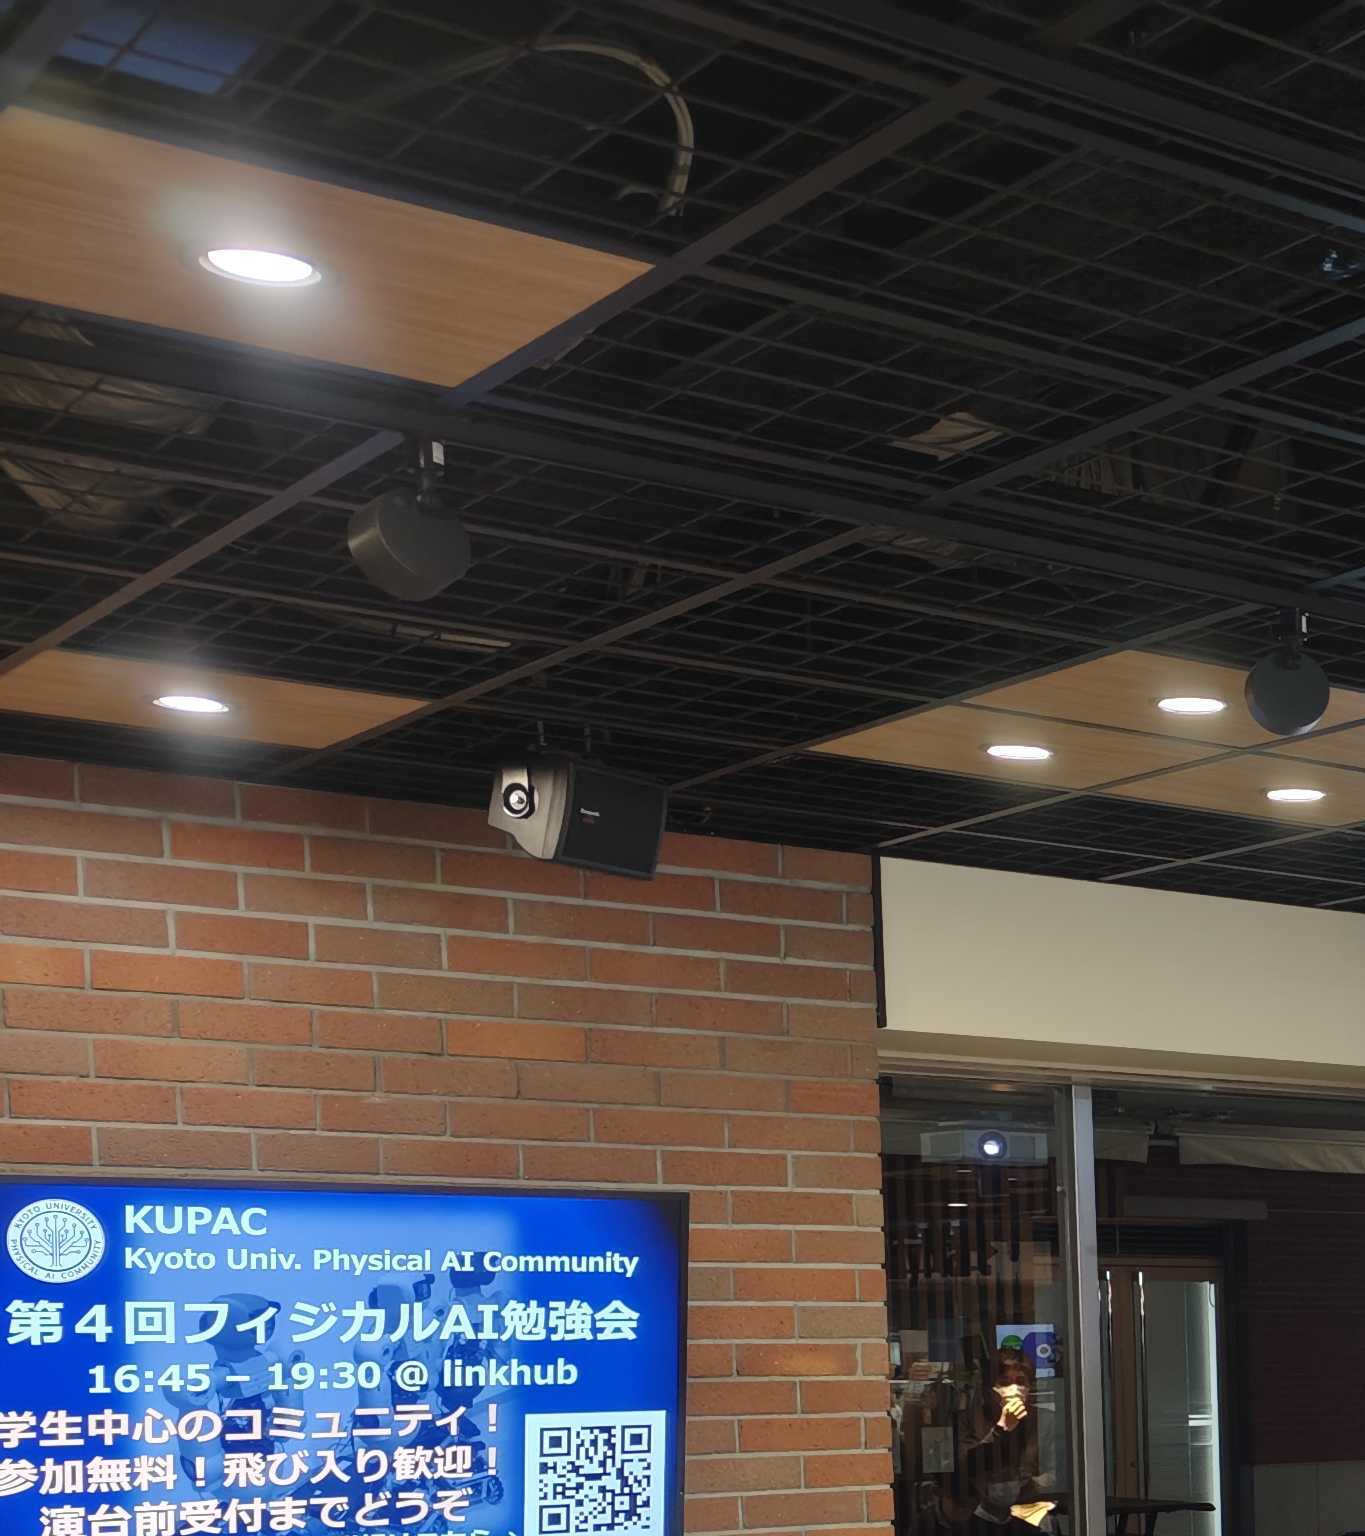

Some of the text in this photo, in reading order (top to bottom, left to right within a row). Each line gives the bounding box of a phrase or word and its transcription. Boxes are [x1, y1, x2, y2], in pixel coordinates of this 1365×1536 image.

[124, 1205, 268, 1236] KUPAC
[124, 1246, 640, 1277] Kyoto Univ. Physical AI Community
[88, 1364, 212, 1394] 16:45
[267, 1361, 382, 1391] 19:30
[395, 1363, 429, 1392] @
[443, 1358, 579, 1388] linkhub
